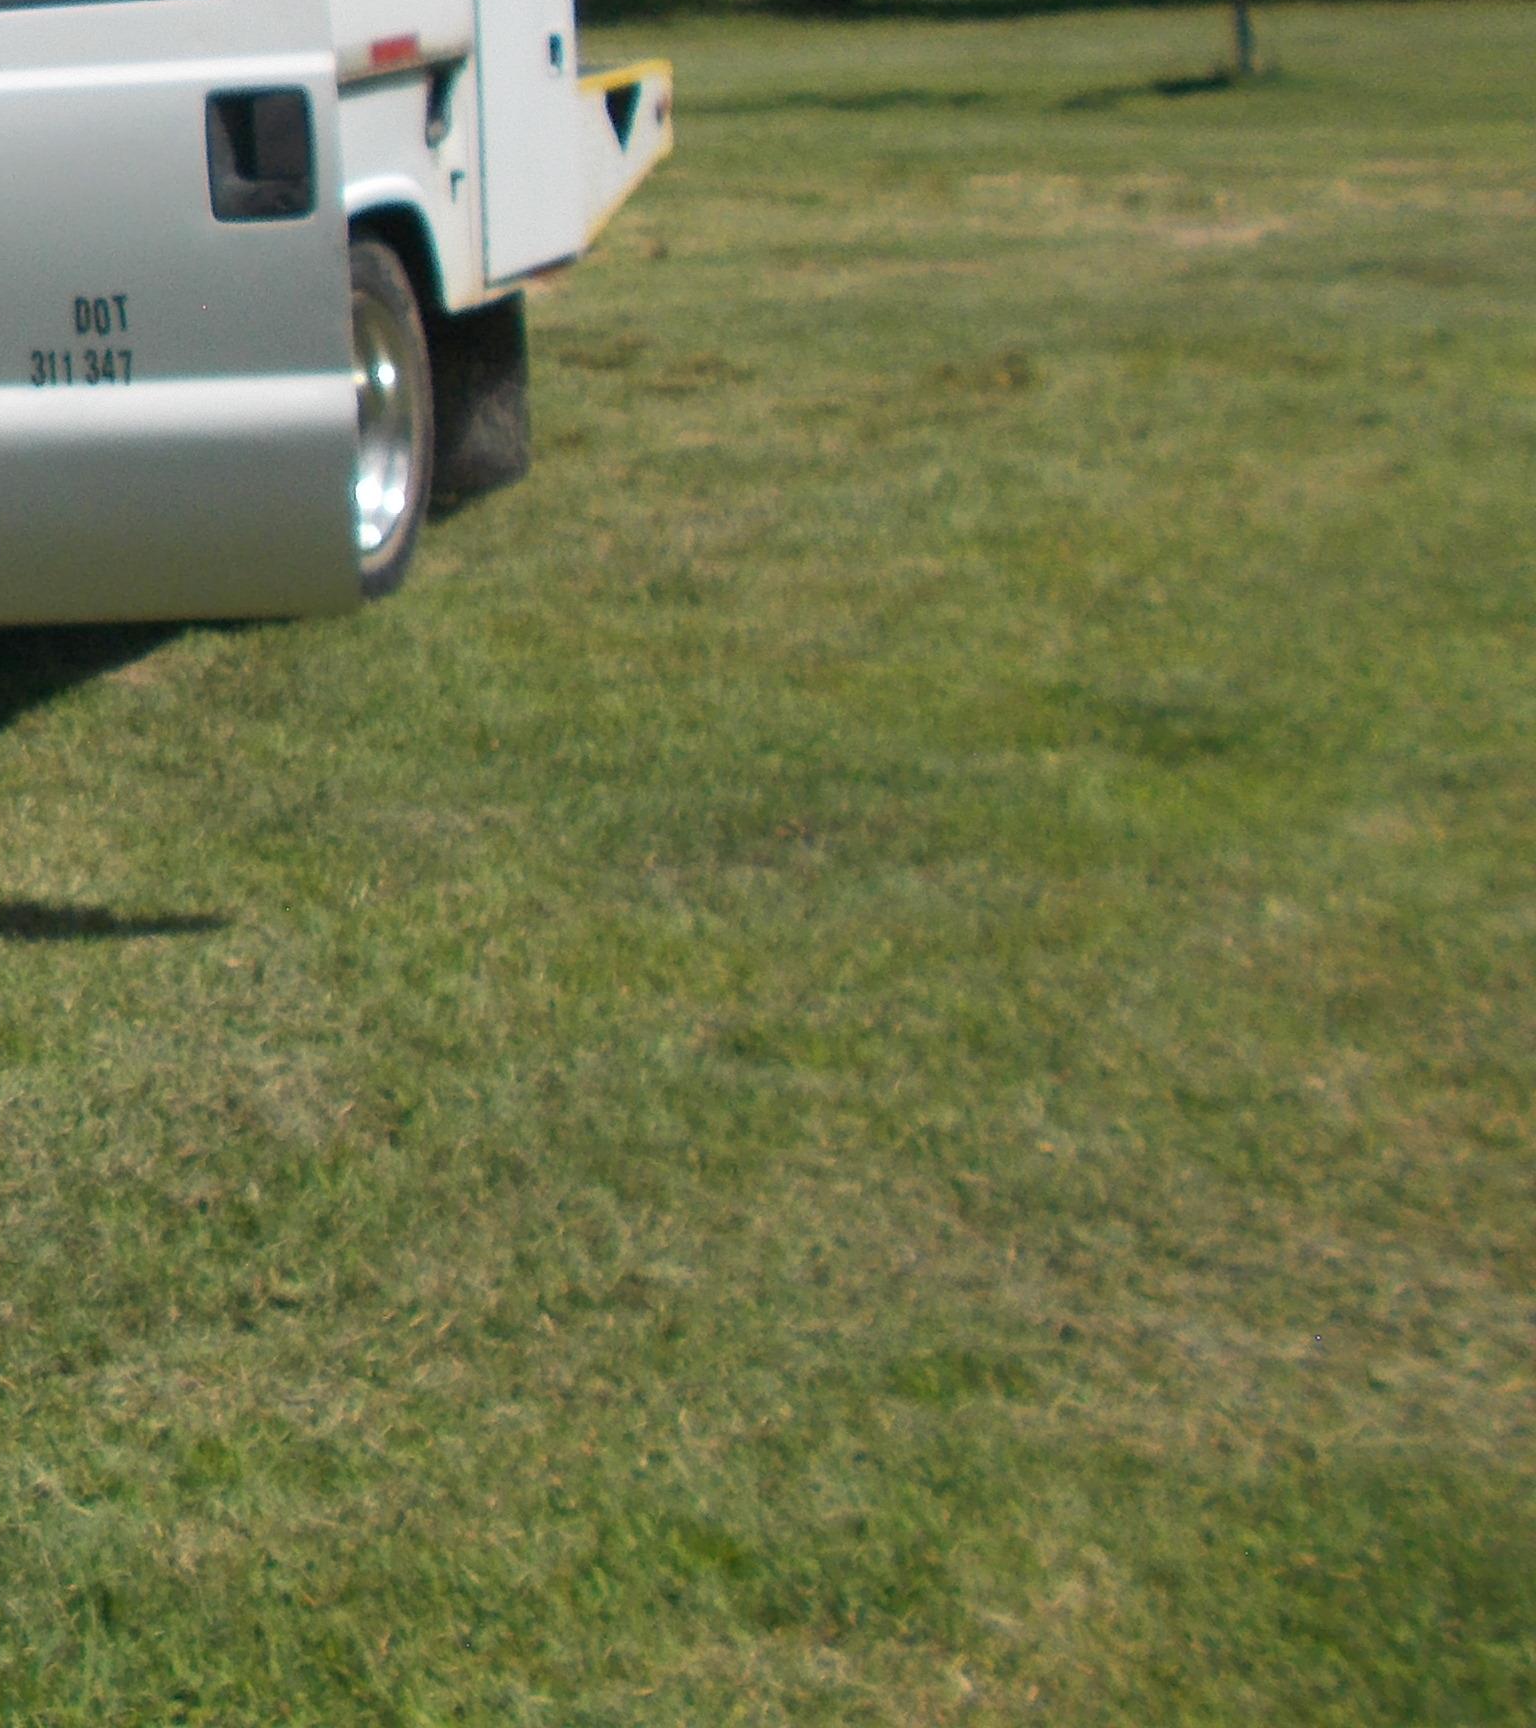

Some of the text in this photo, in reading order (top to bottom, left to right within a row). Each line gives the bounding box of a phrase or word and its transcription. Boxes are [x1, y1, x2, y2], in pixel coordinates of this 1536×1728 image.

[74, 294, 127, 336] DOT
[31, 348, 132, 386] 311 347
